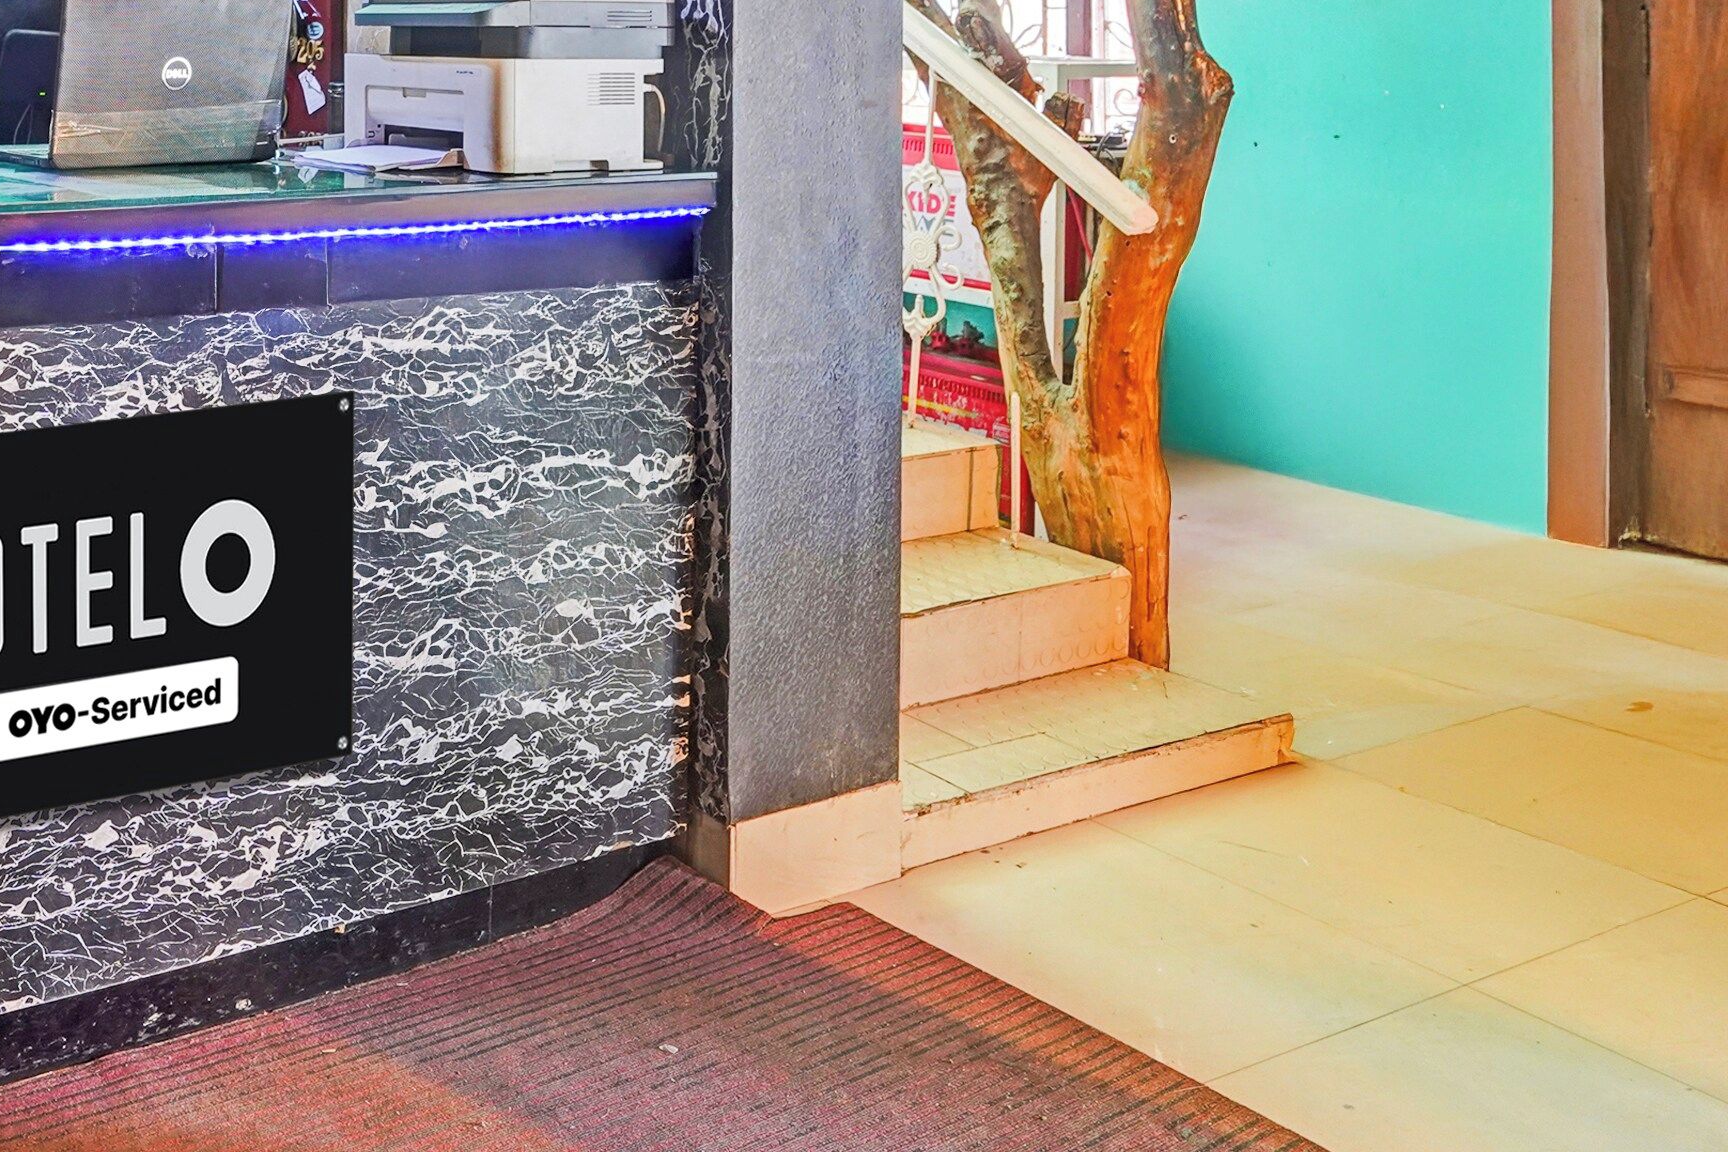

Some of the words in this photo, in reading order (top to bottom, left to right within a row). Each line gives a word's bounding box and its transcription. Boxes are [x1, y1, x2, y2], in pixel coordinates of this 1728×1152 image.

[297, 37, 324, 63] 205
[179, 498, 276, 627] O
[8, 677, 222, 738] OYO-Serviced
